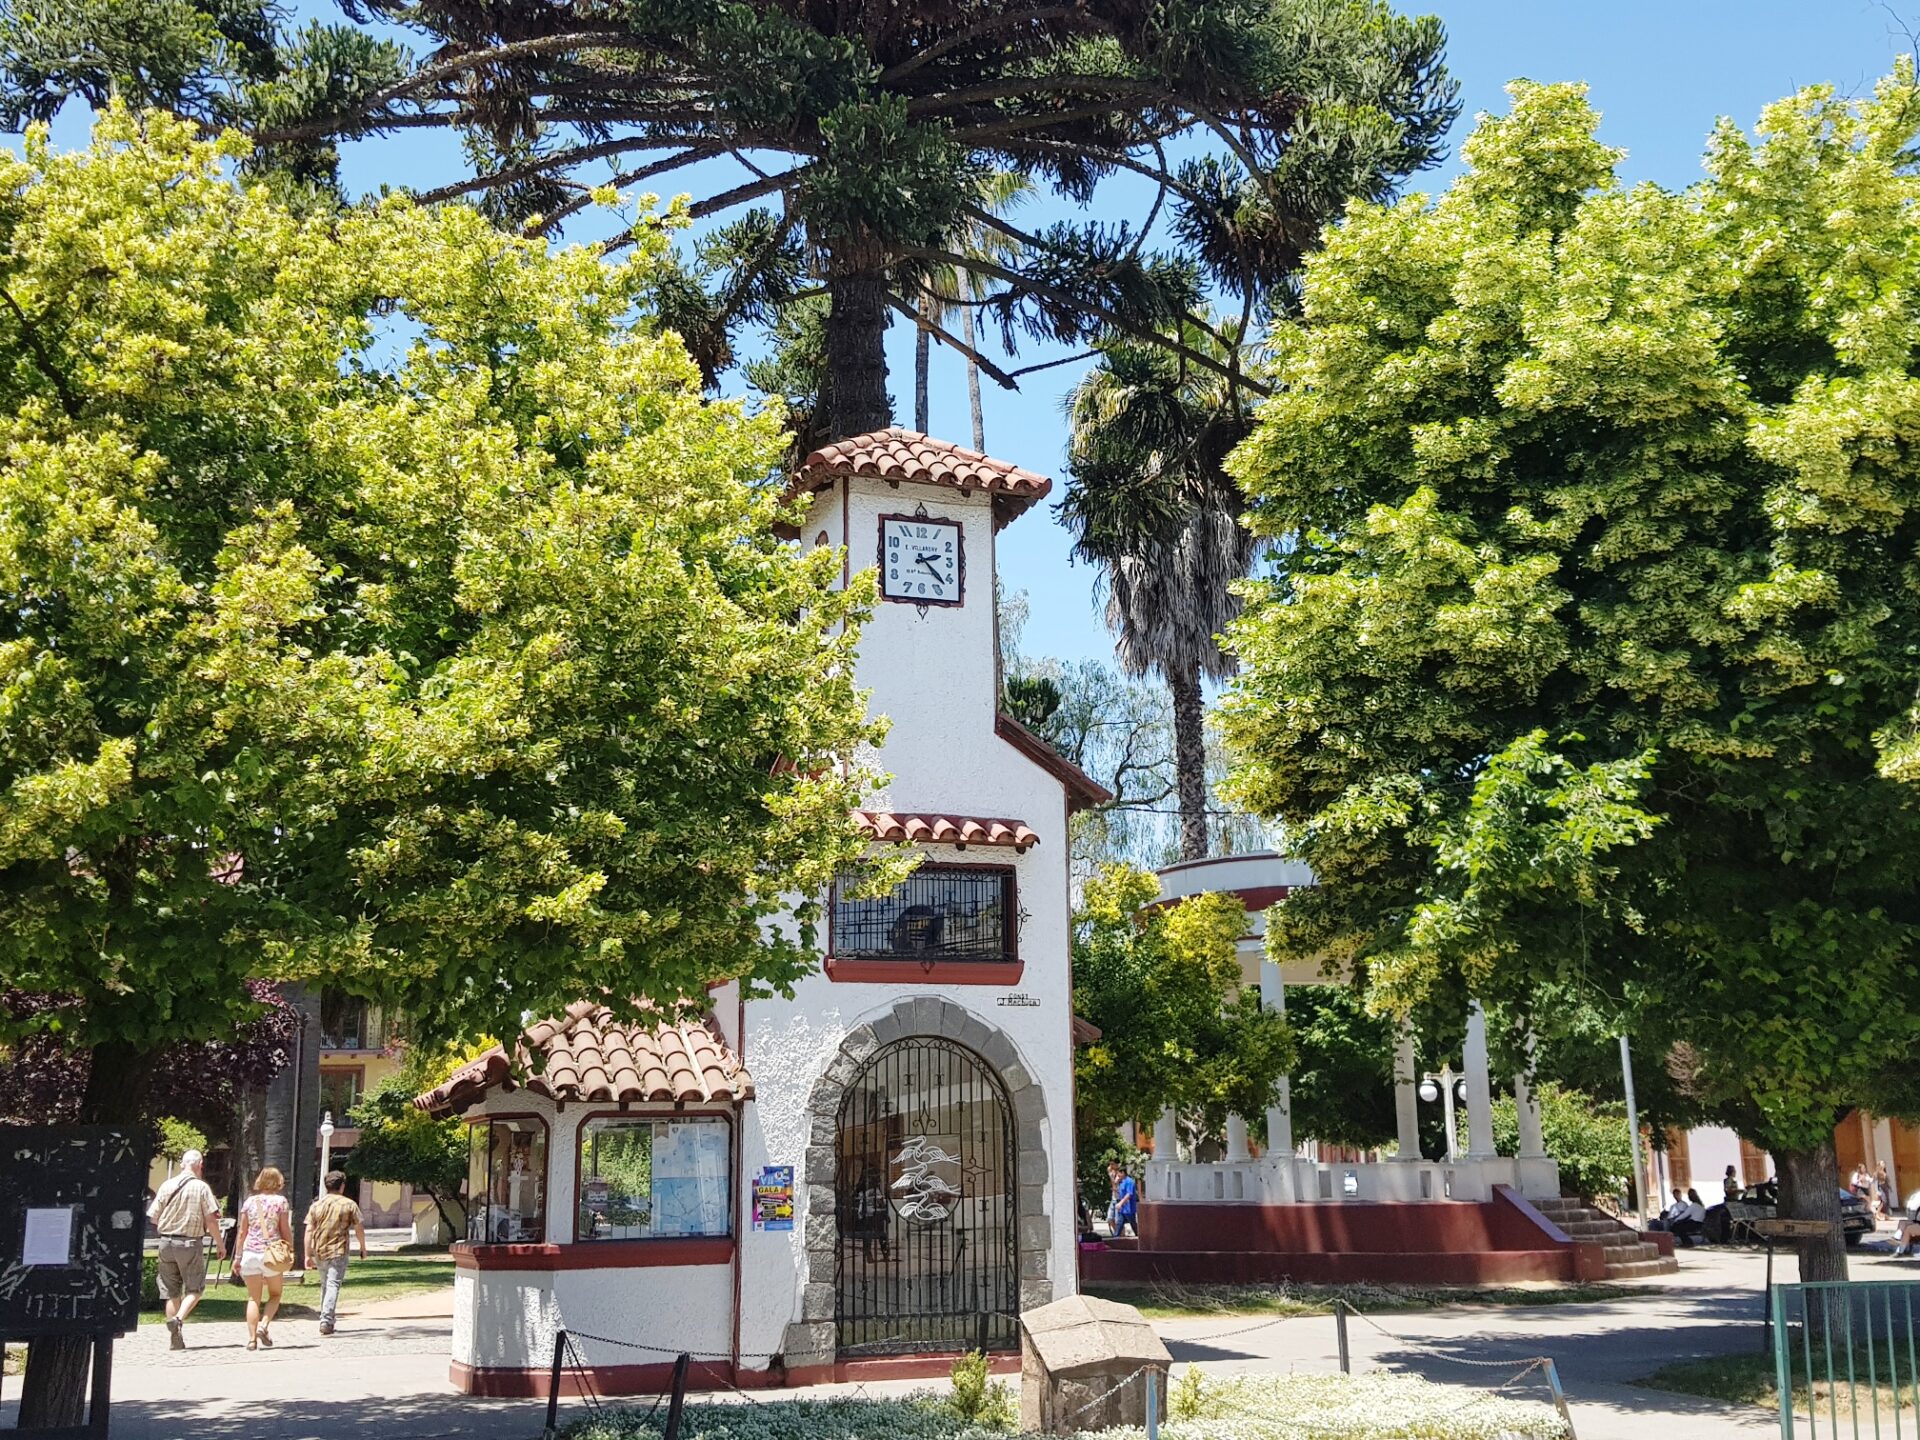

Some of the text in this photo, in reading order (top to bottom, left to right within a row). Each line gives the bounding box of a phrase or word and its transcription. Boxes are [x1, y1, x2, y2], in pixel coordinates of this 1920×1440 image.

[916, 527, 928, 539] 12
[888, 536, 899, 548] 10
[945, 541, 952, 553] 2
[890, 552, 899, 563] 9
[945, 557, 953, 568] 3
[890, 568, 899, 580] 8
[945, 573, 954, 584] 4
[903, 581, 912, 593] 7
[917, 582, 926, 594] 6
